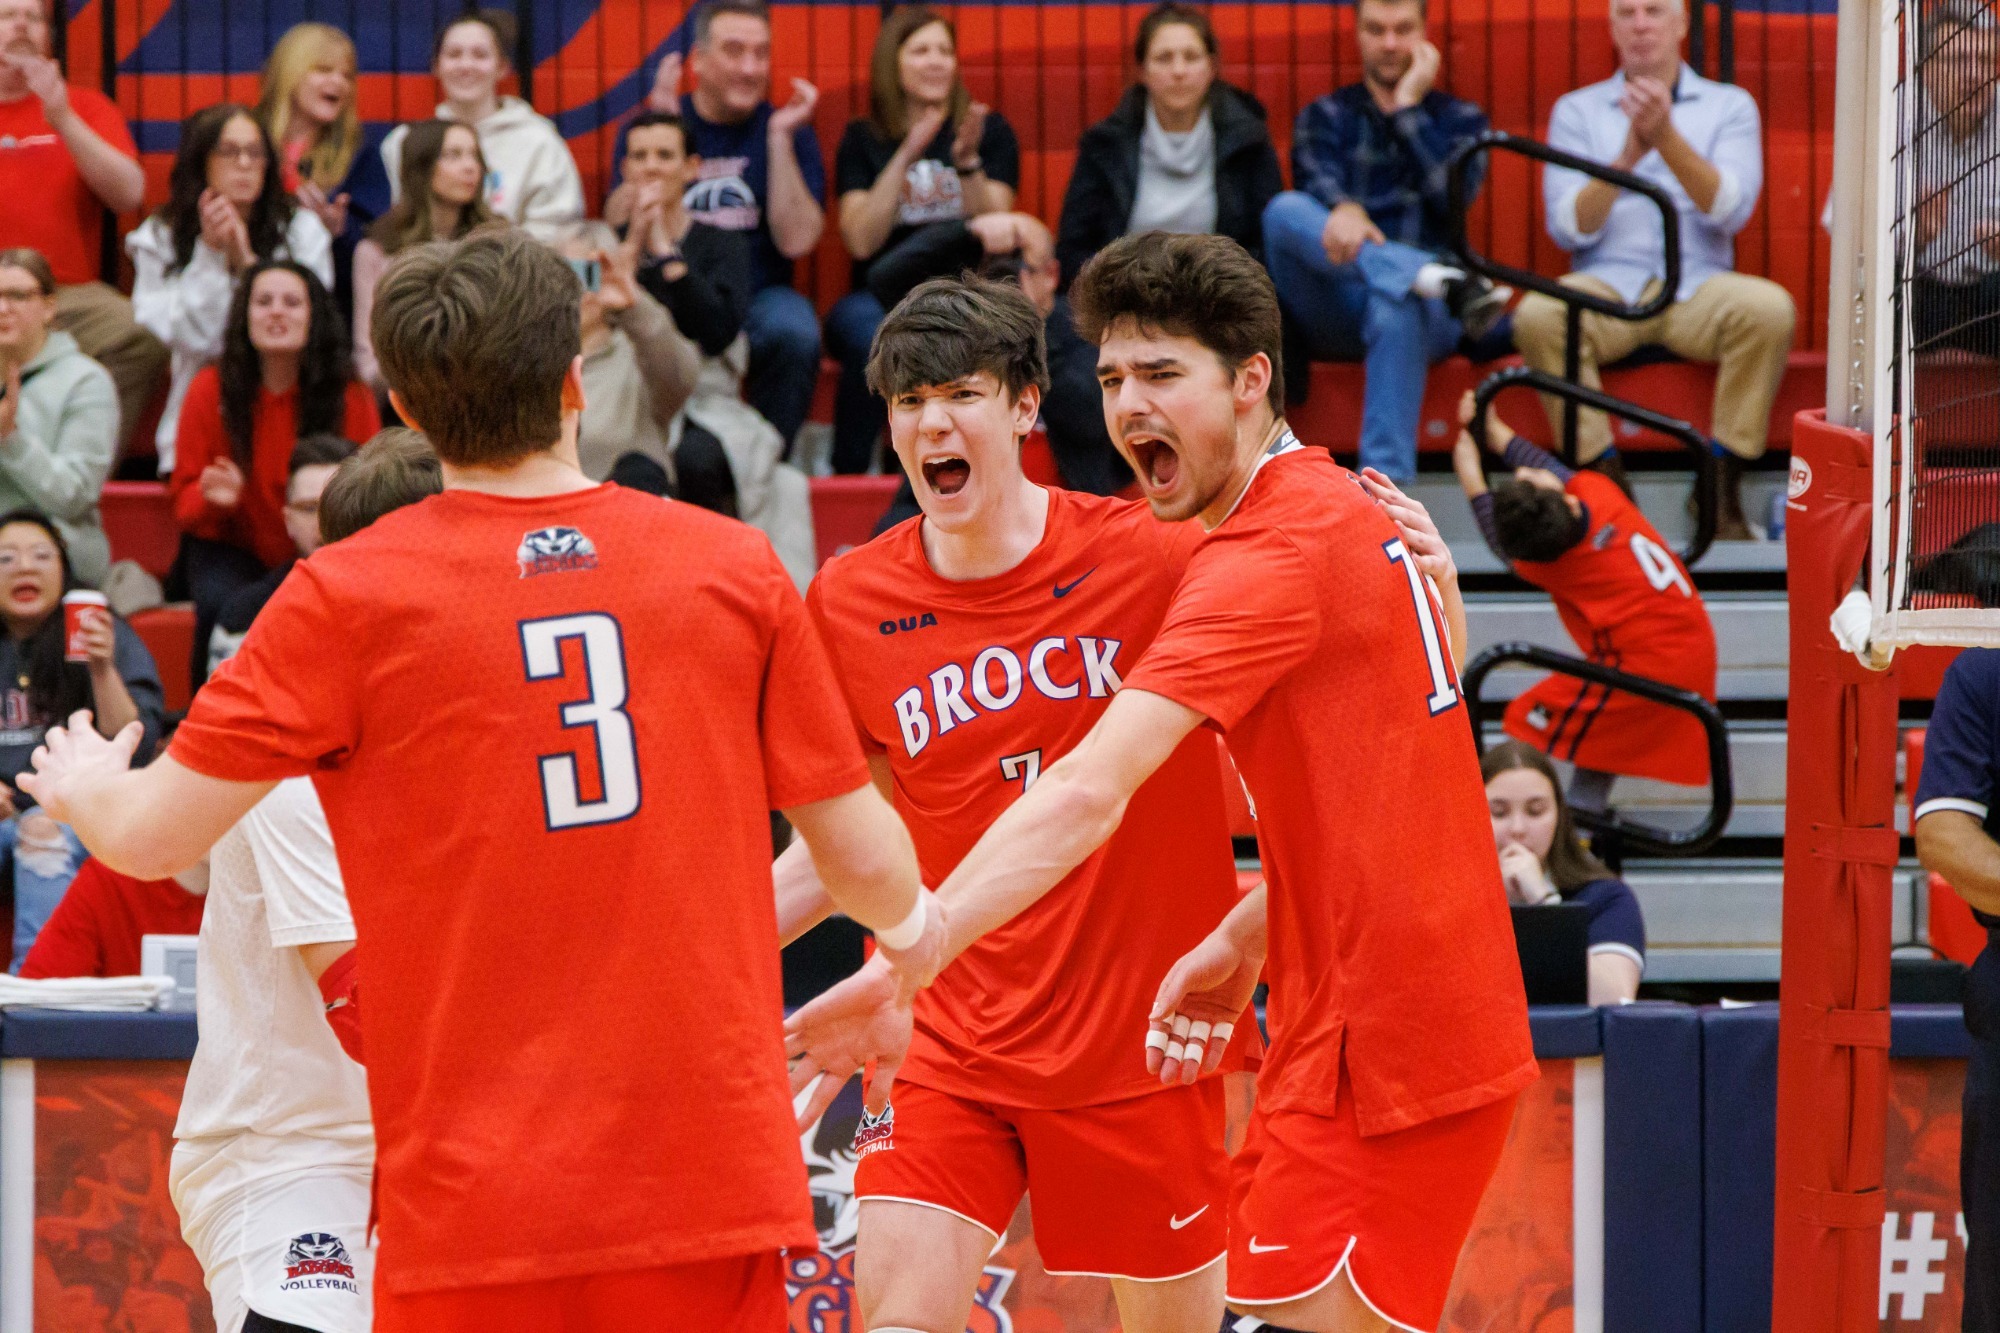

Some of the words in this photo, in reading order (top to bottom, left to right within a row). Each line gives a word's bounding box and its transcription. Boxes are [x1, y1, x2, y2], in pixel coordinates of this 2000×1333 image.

[879, 612, 938, 635] OUA
[1381, 536, 1464, 718] 1
[516, 610, 642, 832] 3
[893, 635, 1123, 759] BROCK
[1000, 748, 1042, 794] 7
[280, 1279, 360, 1295] VOLLEYBALL
